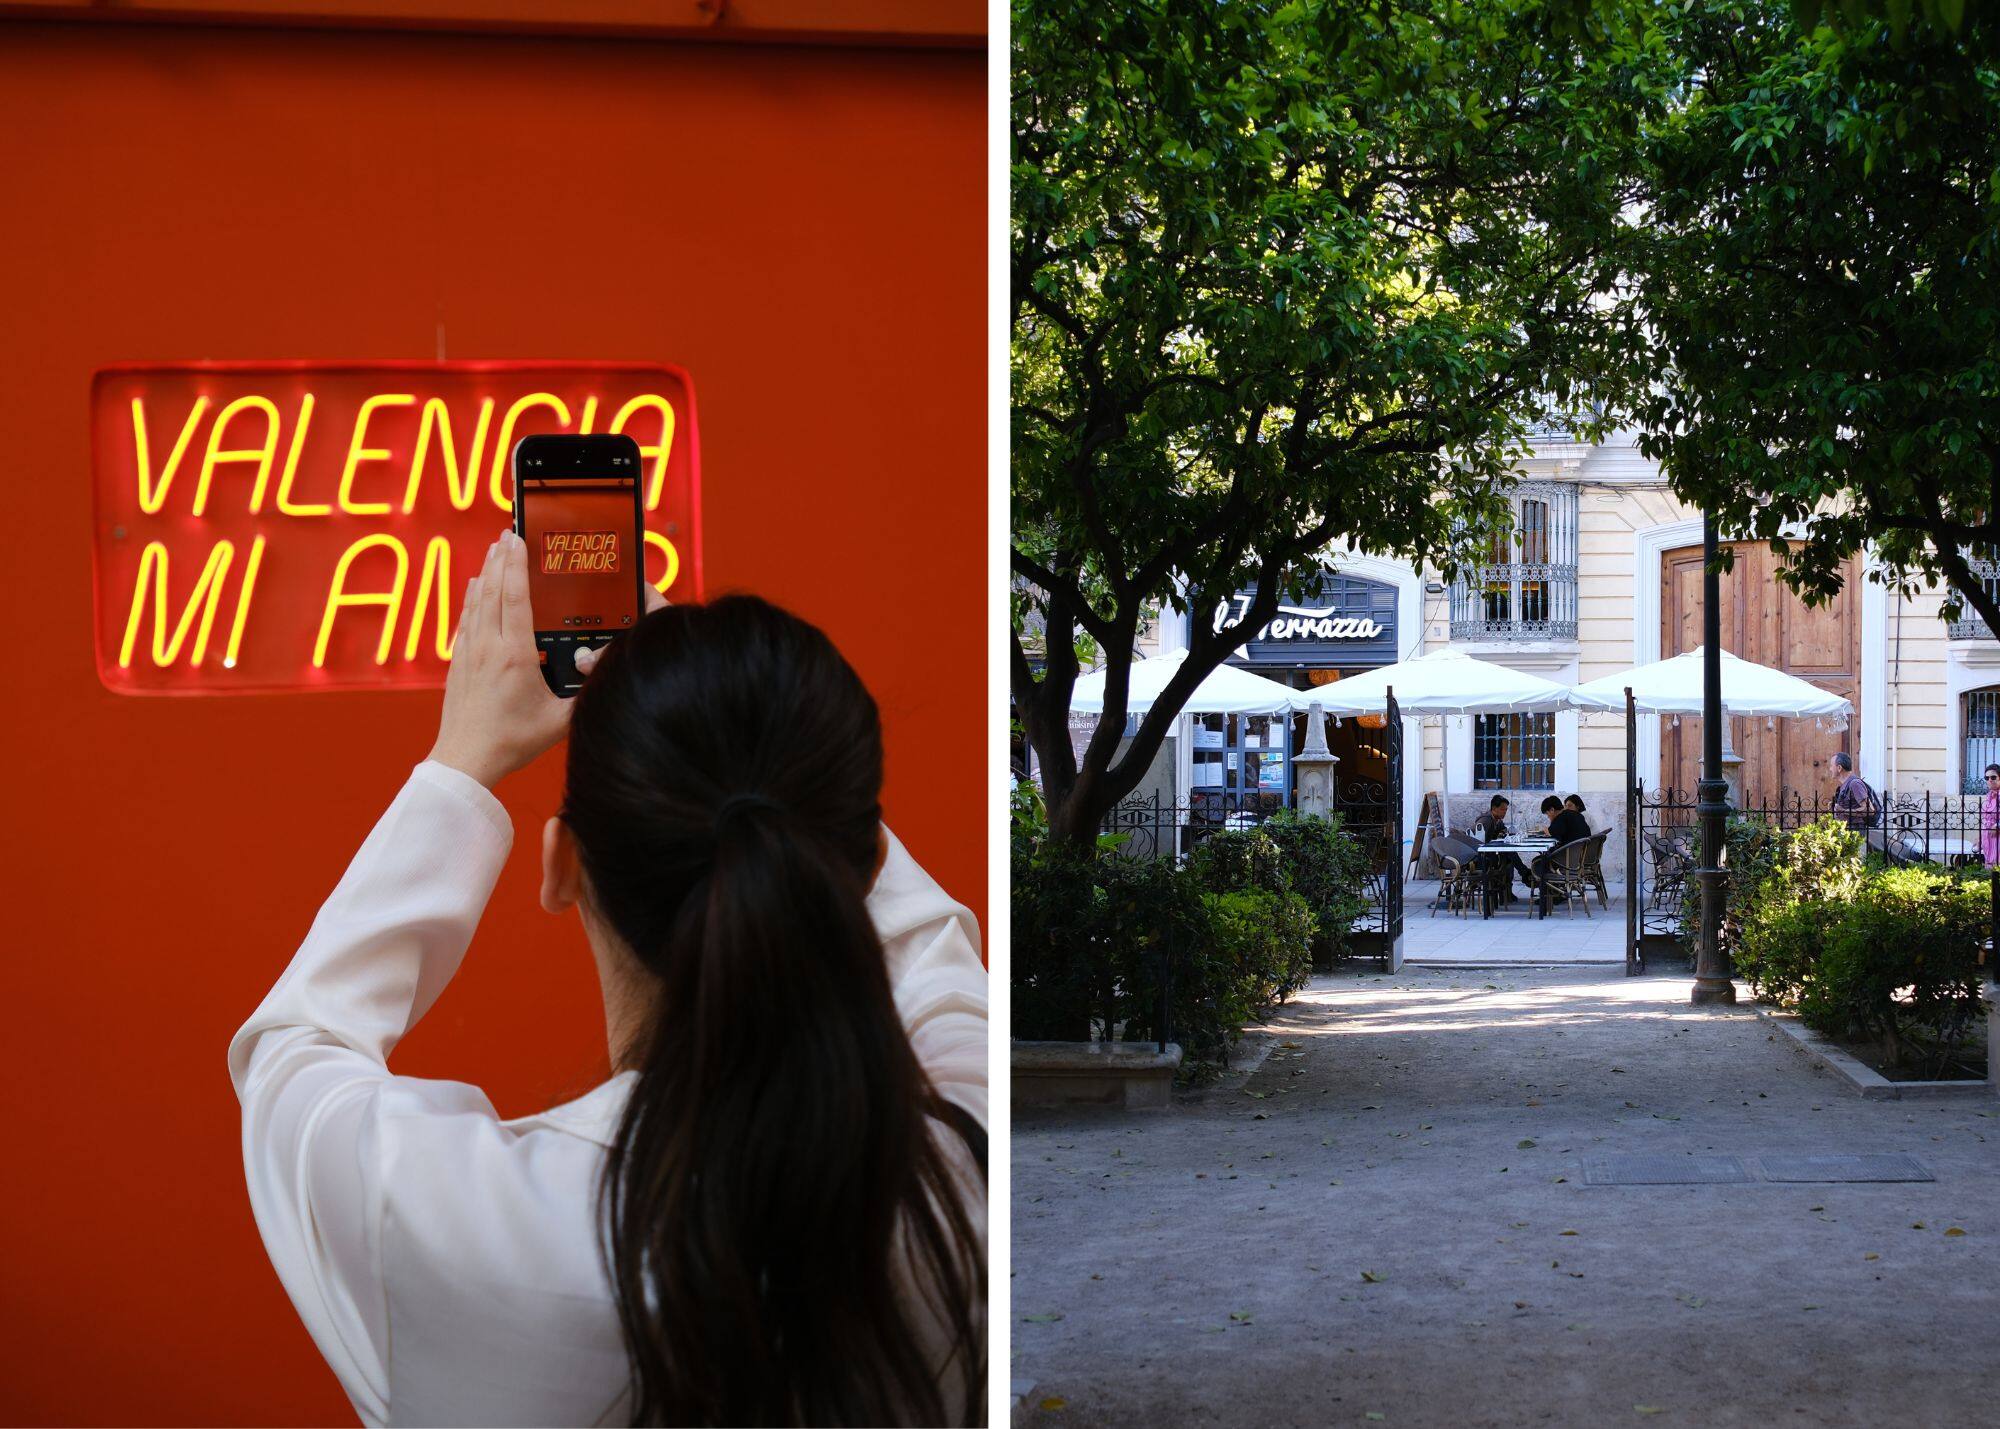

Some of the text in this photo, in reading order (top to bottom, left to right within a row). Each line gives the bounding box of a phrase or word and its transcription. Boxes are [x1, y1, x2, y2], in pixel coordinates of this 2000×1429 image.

[546, 534, 617, 551] VALENCIA
[545, 552, 617, 571] MI AMOR
[118, 534, 265, 669] MI
